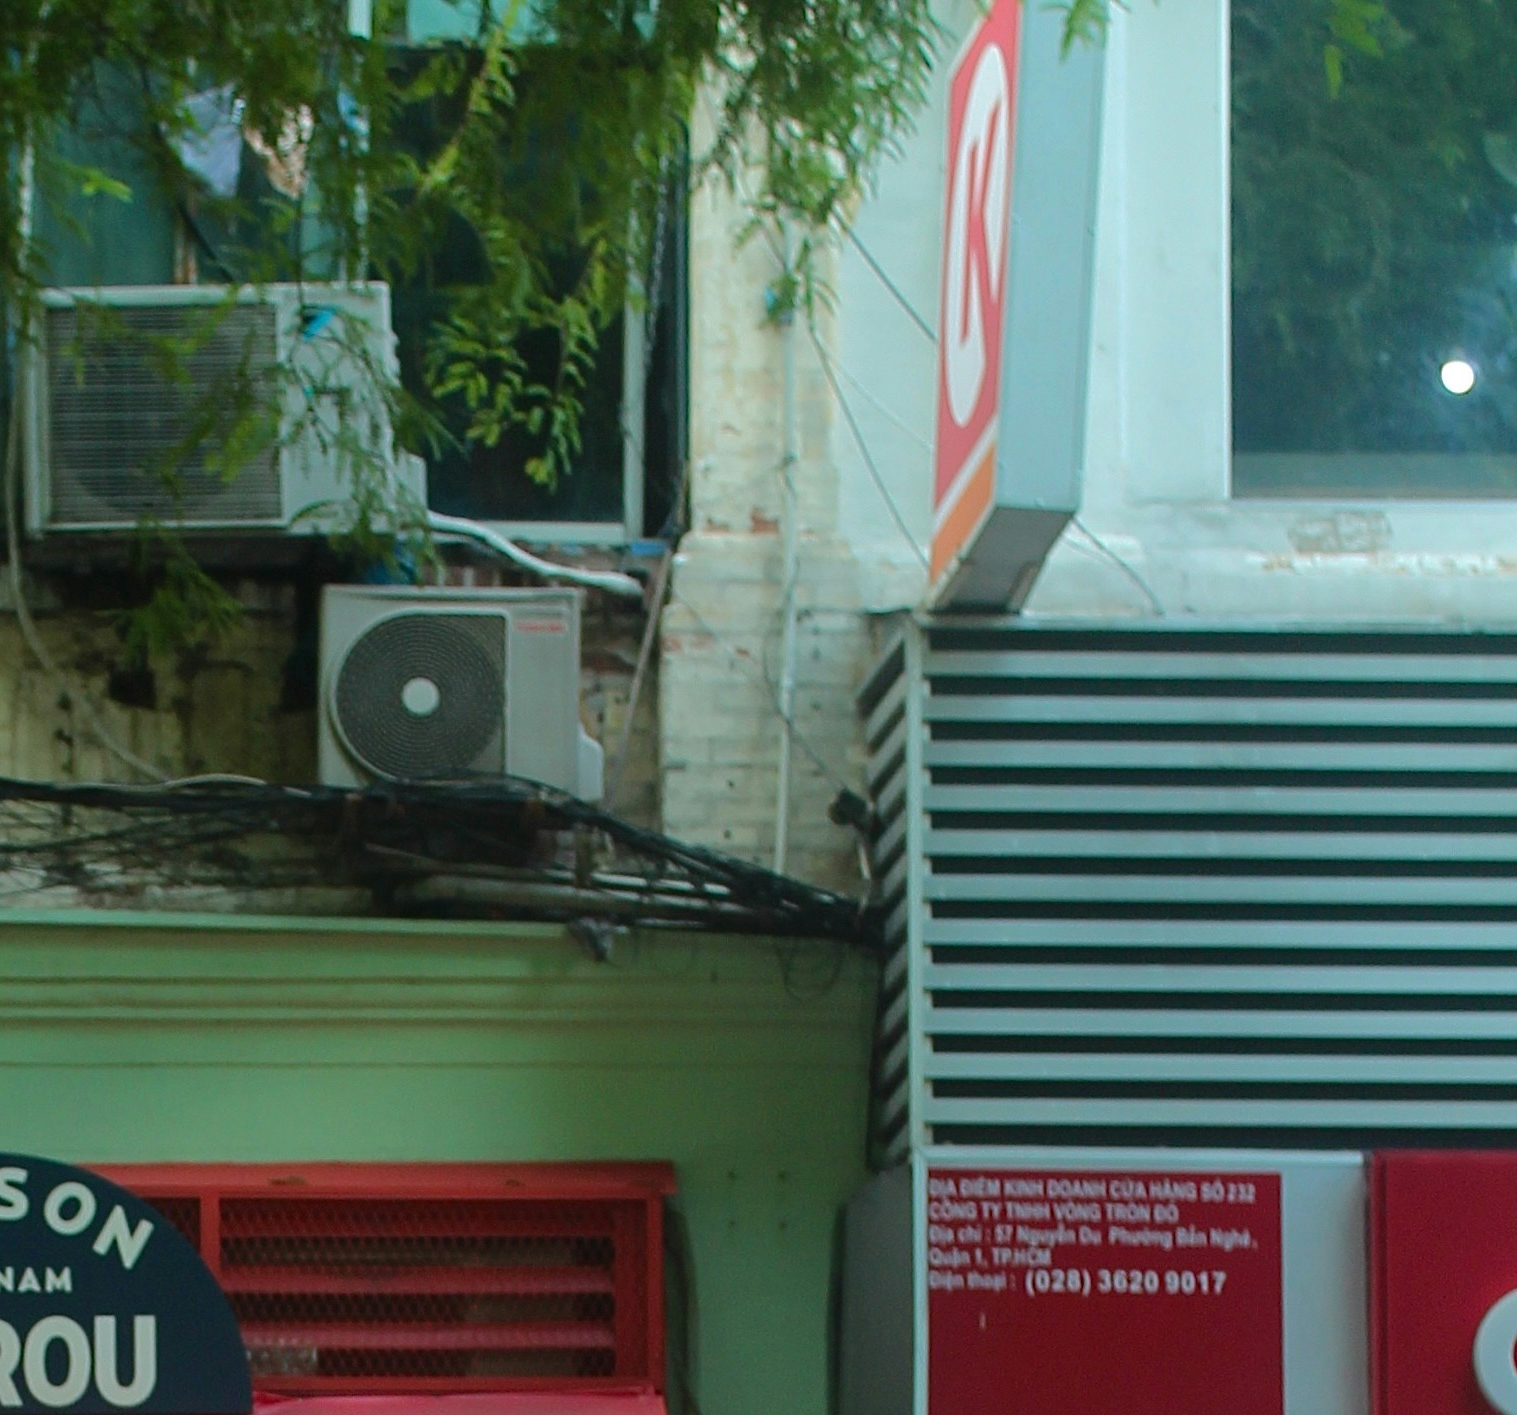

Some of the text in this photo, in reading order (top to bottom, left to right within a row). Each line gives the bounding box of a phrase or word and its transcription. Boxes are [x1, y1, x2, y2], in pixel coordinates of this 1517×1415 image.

[982, 1203, 1001, 1219] TY
[1025, 1269, 1091, 1297] (028)
[1097, 1270, 1159, 1294] 3620
[1165, 1271, 1227, 1295] 9017
